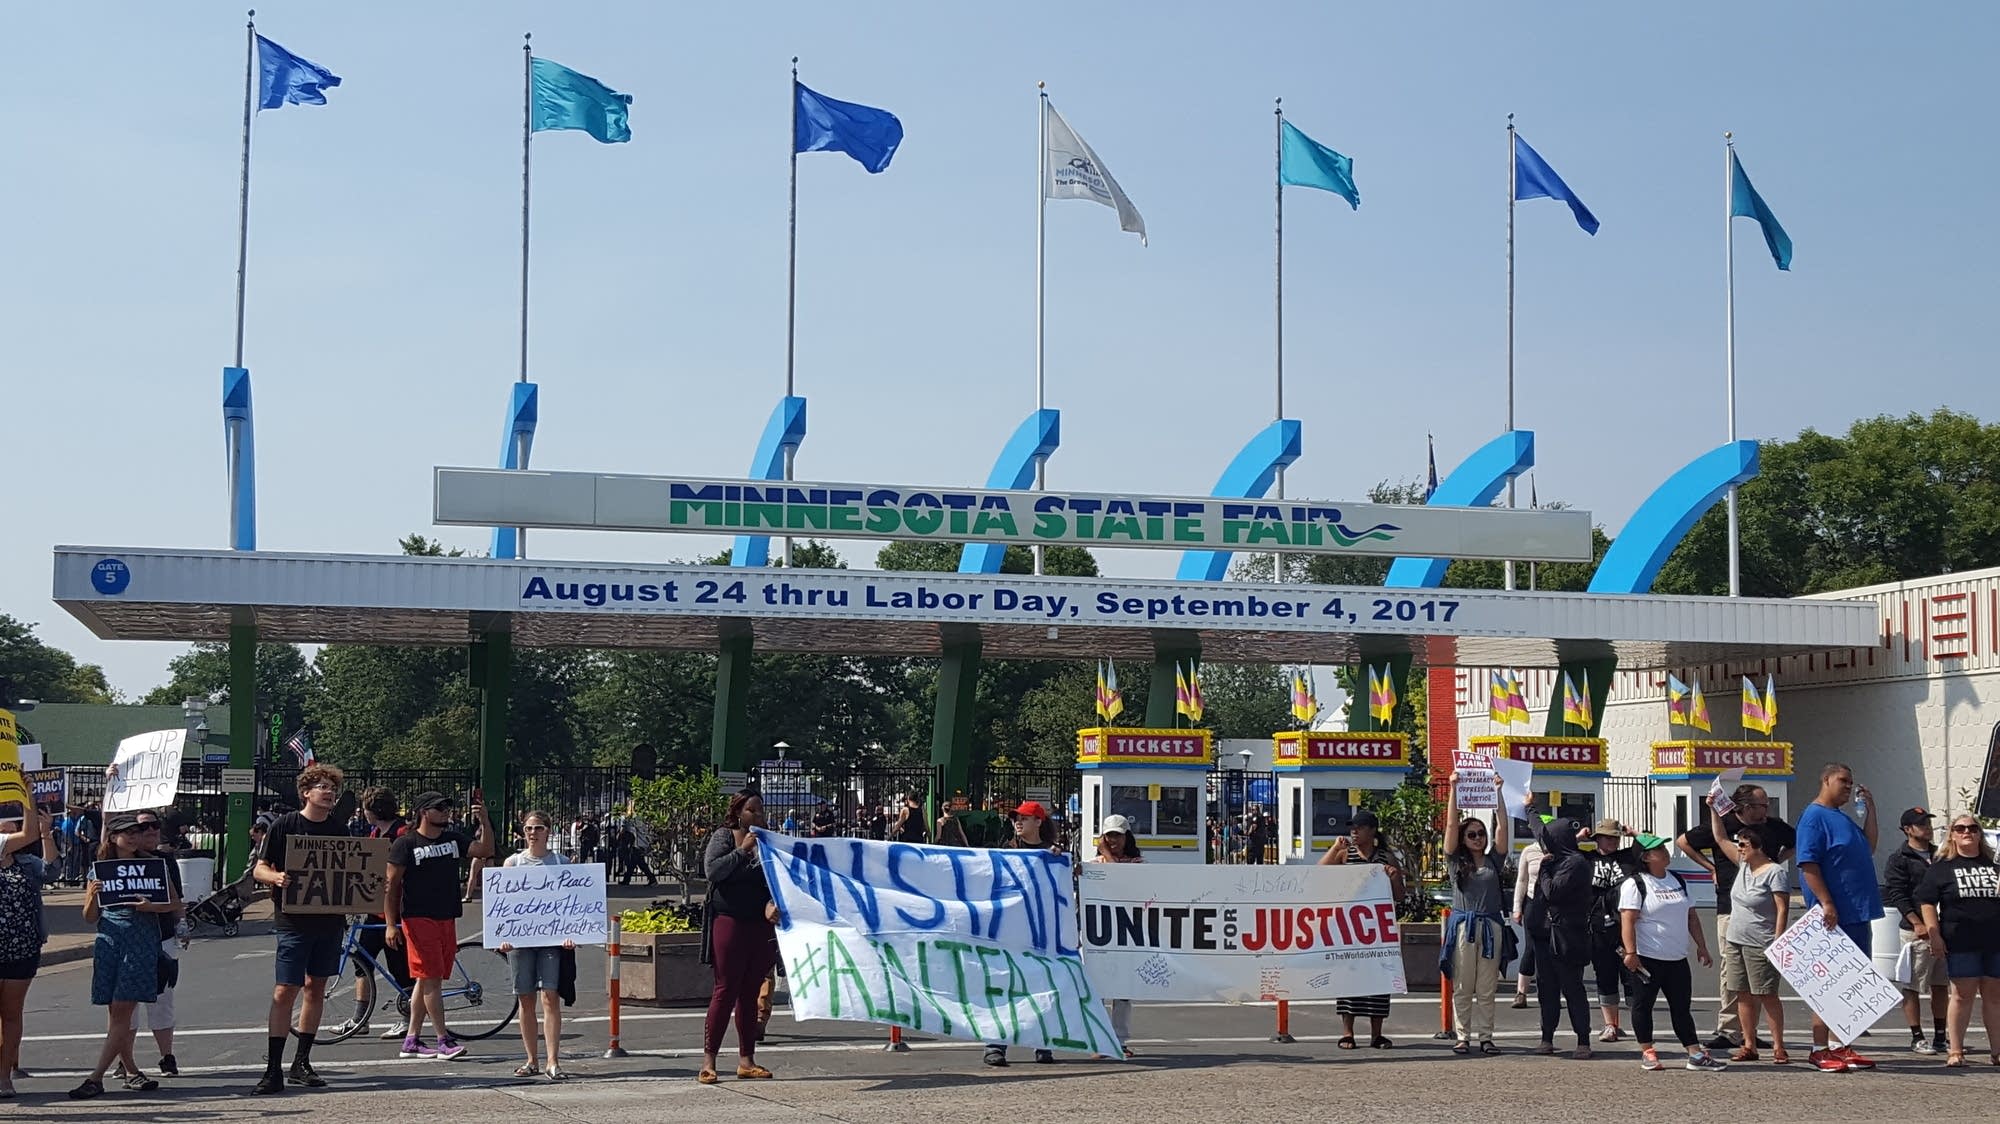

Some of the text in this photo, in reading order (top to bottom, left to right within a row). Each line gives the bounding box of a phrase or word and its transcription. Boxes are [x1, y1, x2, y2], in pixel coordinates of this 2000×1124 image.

[670, 483, 1400, 547] MINNESOTA STATE FAIR
[97, 563, 124, 571] GATE
[105, 571, 116, 583] 5
[523, 576, 1460, 623] August 24 thru Labor Day, September 4, 2017
[1117, 739, 1194, 754] TICKETS
[1317, 742, 1393, 756] TICKETS
[1519, 746, 1592, 761] TICKETS
[1456, 759, 1491, 768] AGAINST
[1459, 752, 1486, 761] STAND
[1658, 751, 1685, 765] TICKETS
[1703, 751, 1776, 765] TICKETS
[113, 751, 178, 781] ILLING
[35, 770, 60, 780] WHAT
[107, 782, 168, 810] KIDS
[294, 838, 363, 851] MINNESOTA
[413, 840, 460, 866] PANTERA
[117, 864, 146, 877] SAY
[1954, 866, 1996, 878] BLACK
[102, 877, 165, 892] HIS NAME.
[286, 870, 374, 906] FAIR
[486, 869, 594, 895] Rest In Peace
[1957, 875, 1999, 889] LIVES
[1085, 903, 1400, 951] UNITE FOR JUSTICE
[1827, 938, 1855, 964] Shot
[1812, 961, 1829, 978] 18
